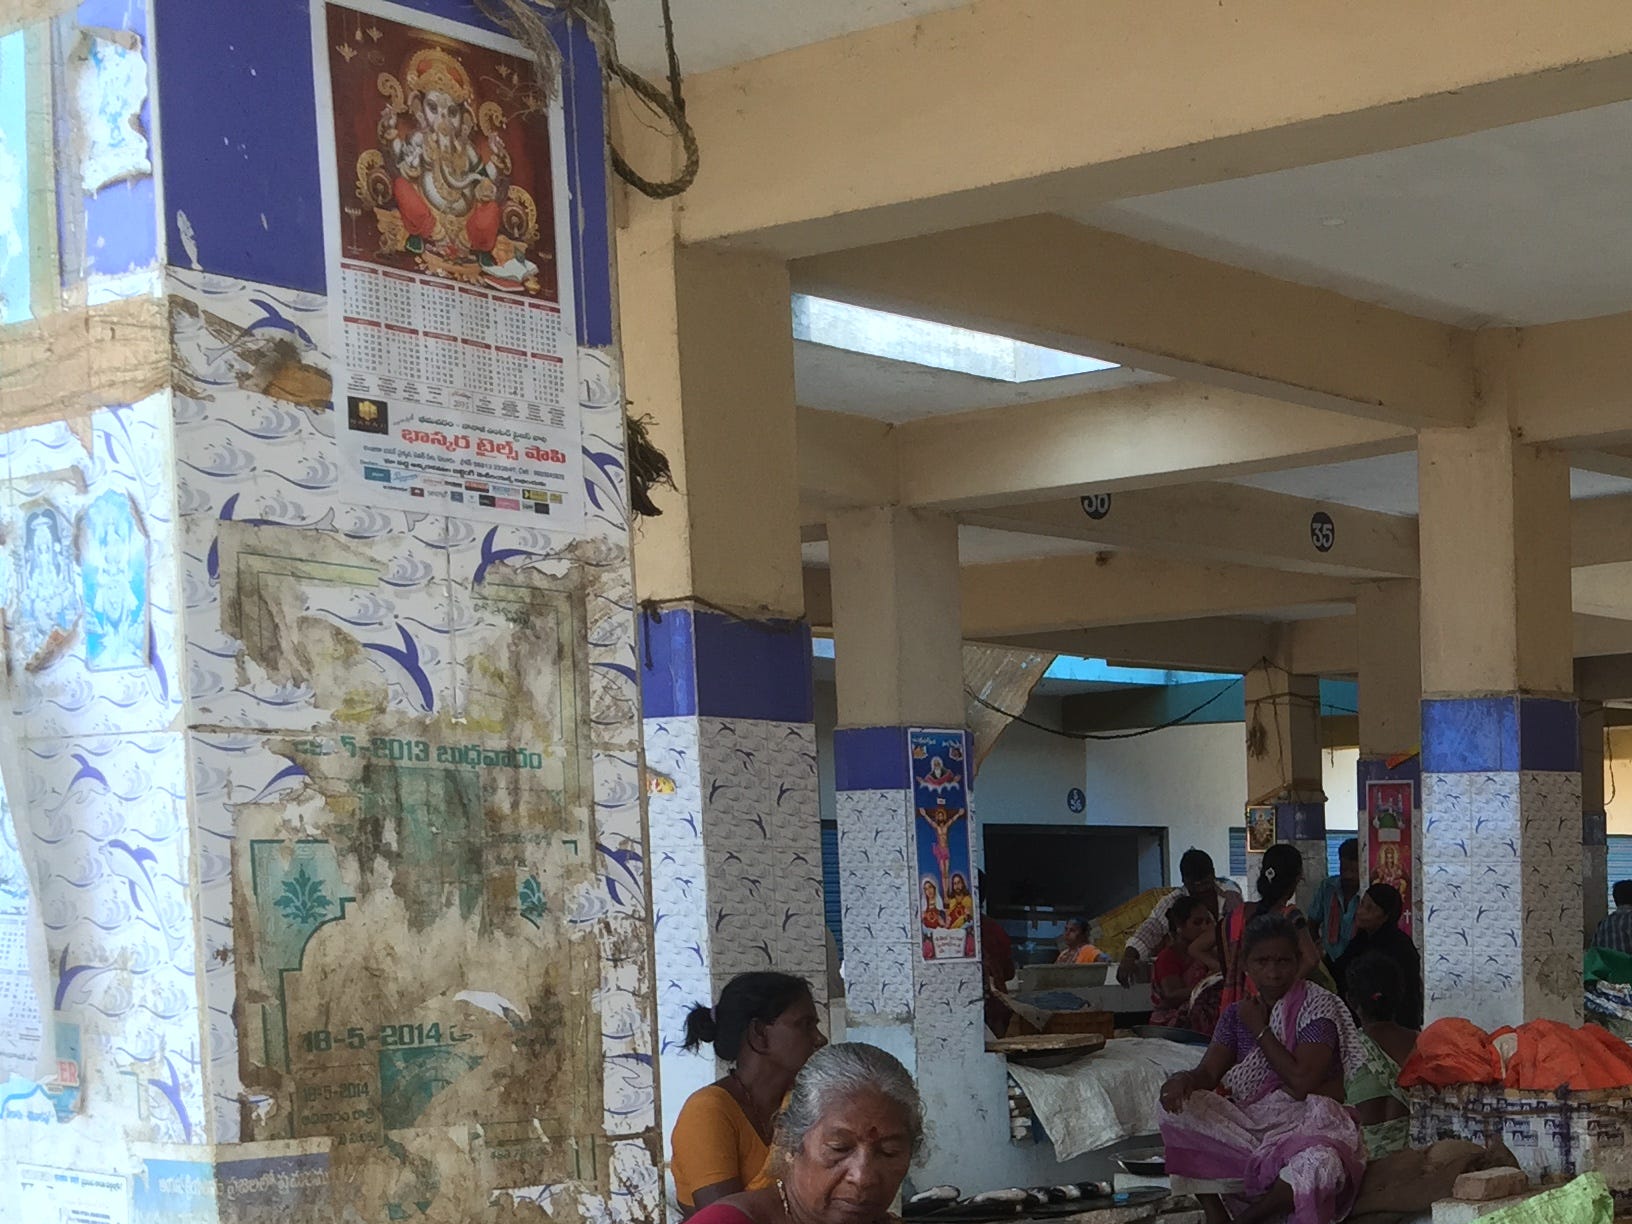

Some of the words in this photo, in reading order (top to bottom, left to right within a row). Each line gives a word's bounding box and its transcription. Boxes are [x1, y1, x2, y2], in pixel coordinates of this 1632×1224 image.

[401, 428, 470, 452] భాస్కర
[1312, 523, 1332, 547] 35
[303, 1022, 443, 1051] 18-5-2014
